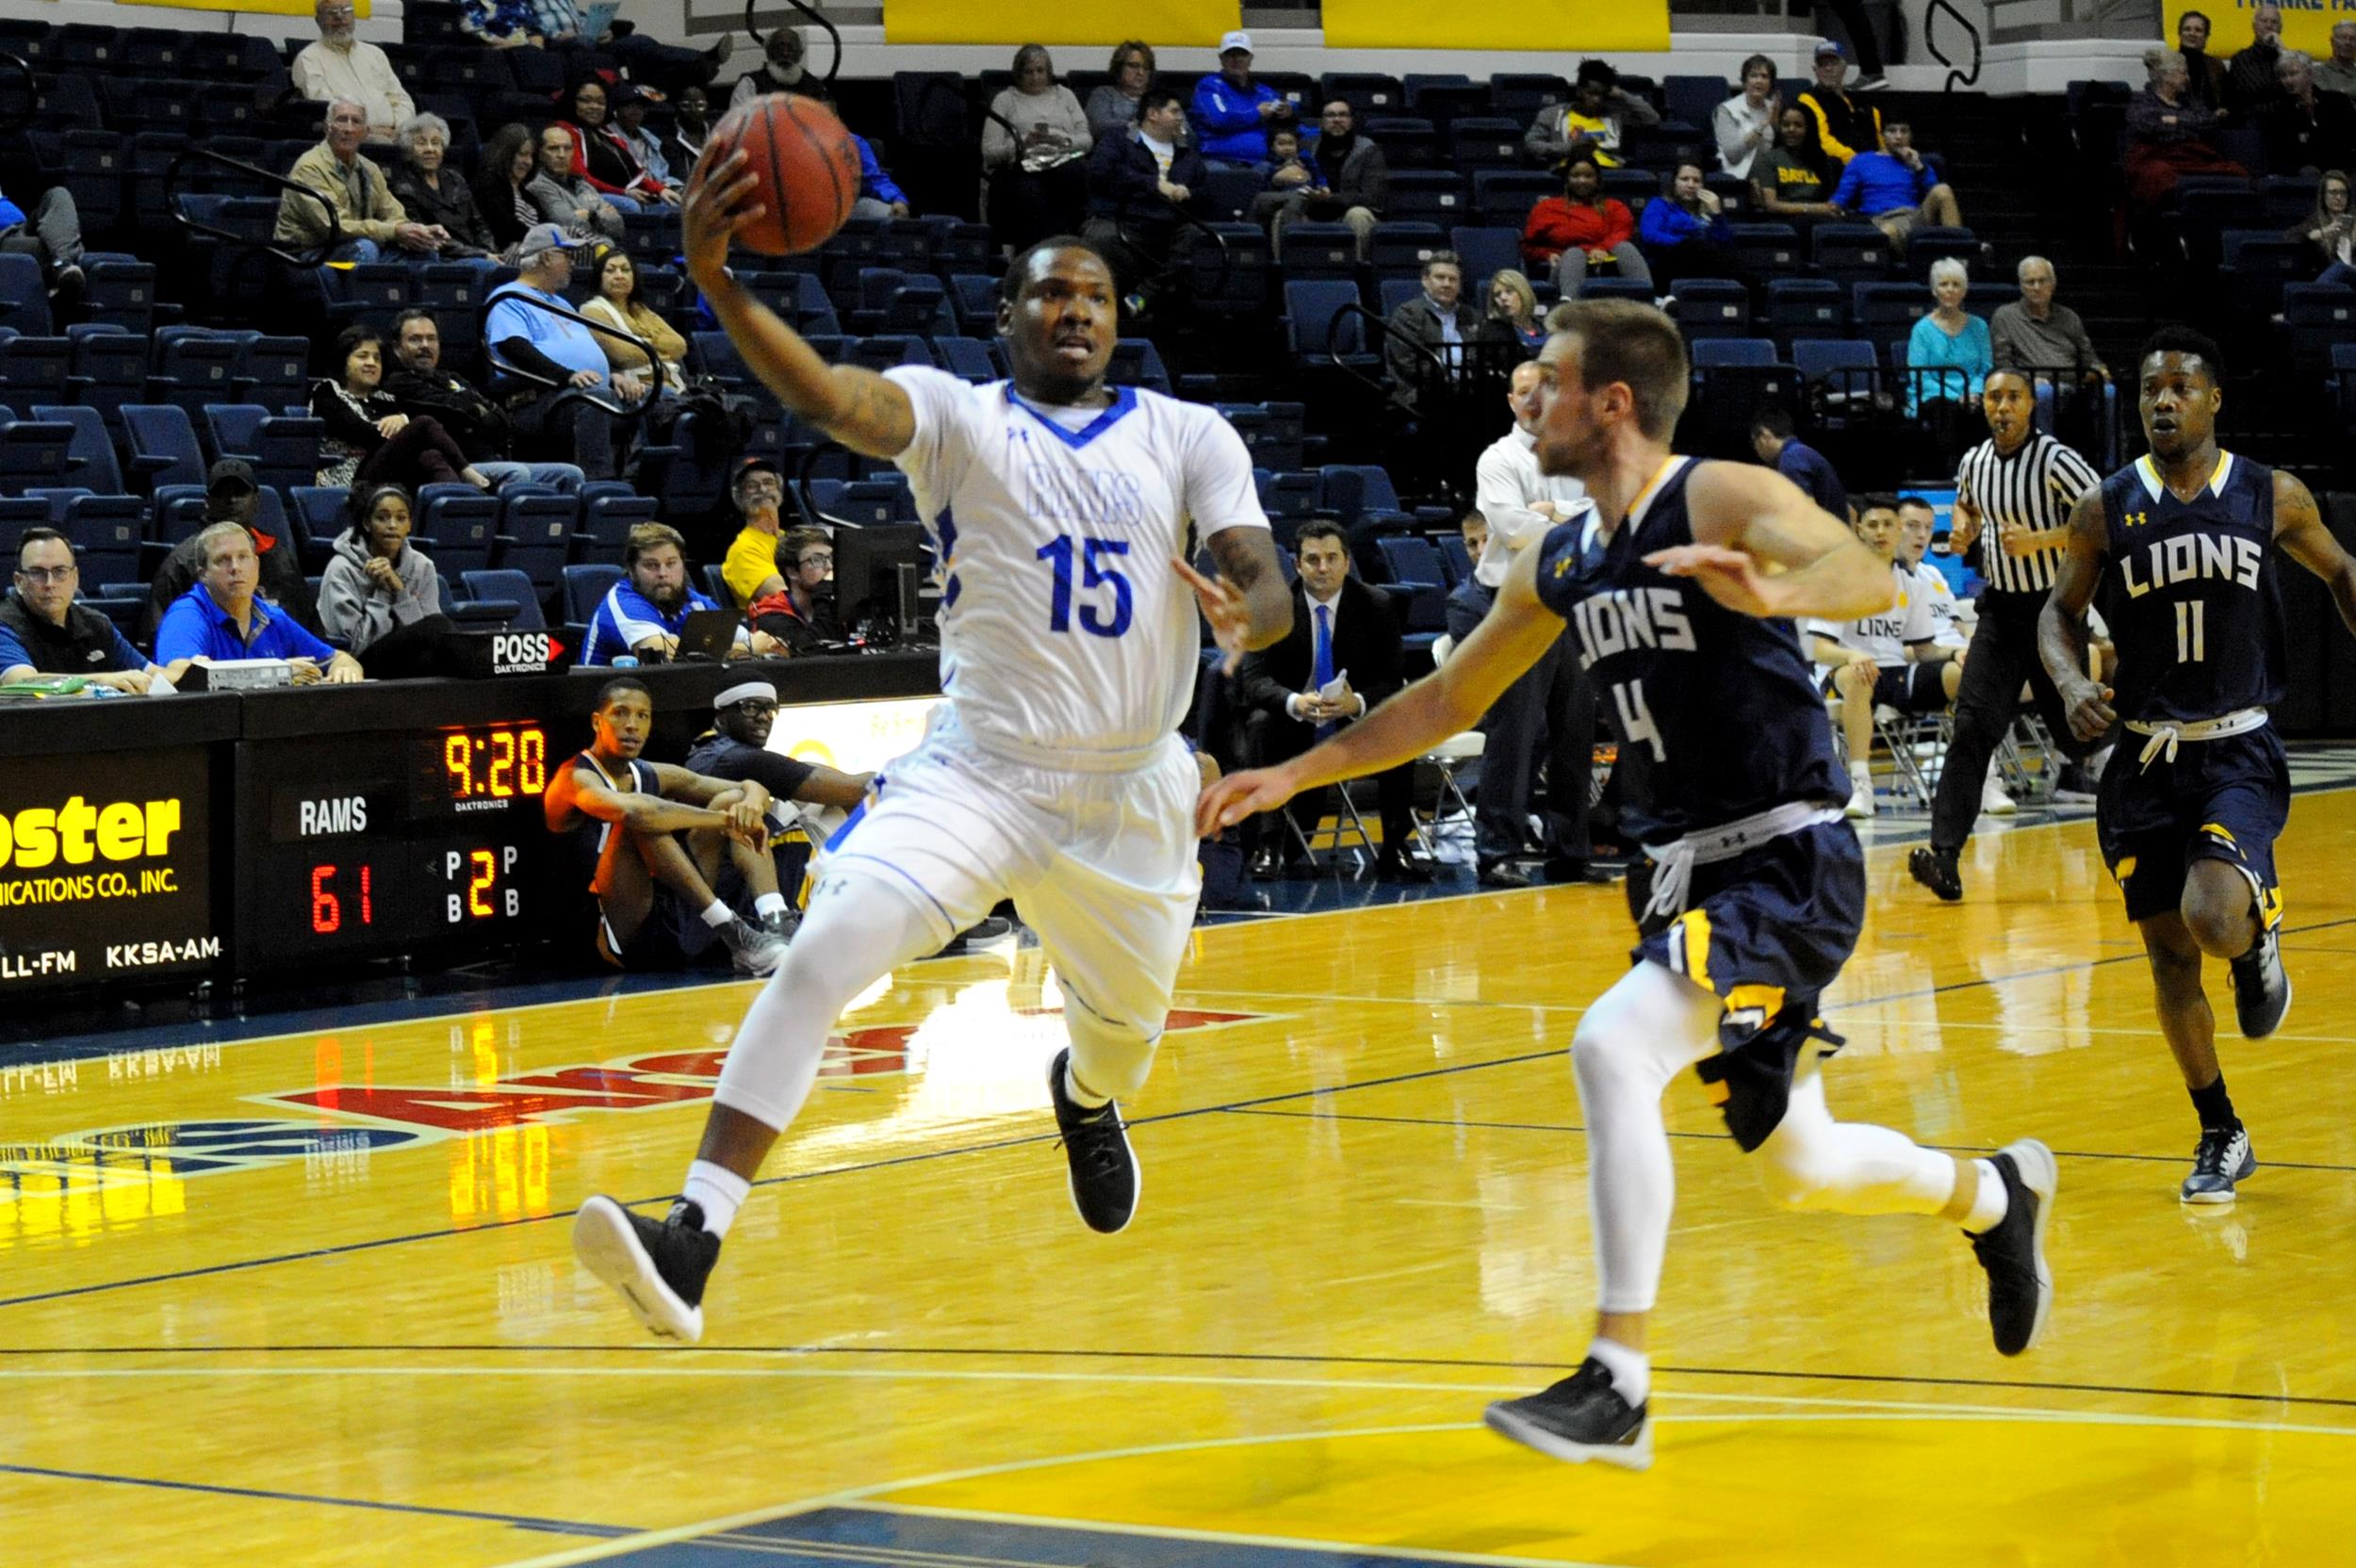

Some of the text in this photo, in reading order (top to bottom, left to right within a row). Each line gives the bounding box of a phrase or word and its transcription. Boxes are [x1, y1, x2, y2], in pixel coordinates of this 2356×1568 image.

[2120, 533, 2262, 598] LIONS
[1037, 533, 1133, 638] 15
[493, 633, 549, 663] POSS
[1573, 587, 1696, 671] IONS
[2174, 600, 2203, 663] 11
[494, 662, 546, 674] DAKTRONICS
[1612, 678, 1666, 761] 4
[446, 730, 545, 796] 9:20
[301, 796, 367, 835] RAMS
[455, 799, 509, 811] DAKTRONICS
[447, 851, 461, 879] P
[504, 846, 517, 874] P
[0, 868, 178, 906] ICATIONS CO., INC.
[312, 865, 371, 932] 61
[470, 851, 494, 916] 2
[448, 894, 461, 923] B
[505, 889, 519, 917] B
[106, 936, 220, 968] KKSA-AM
